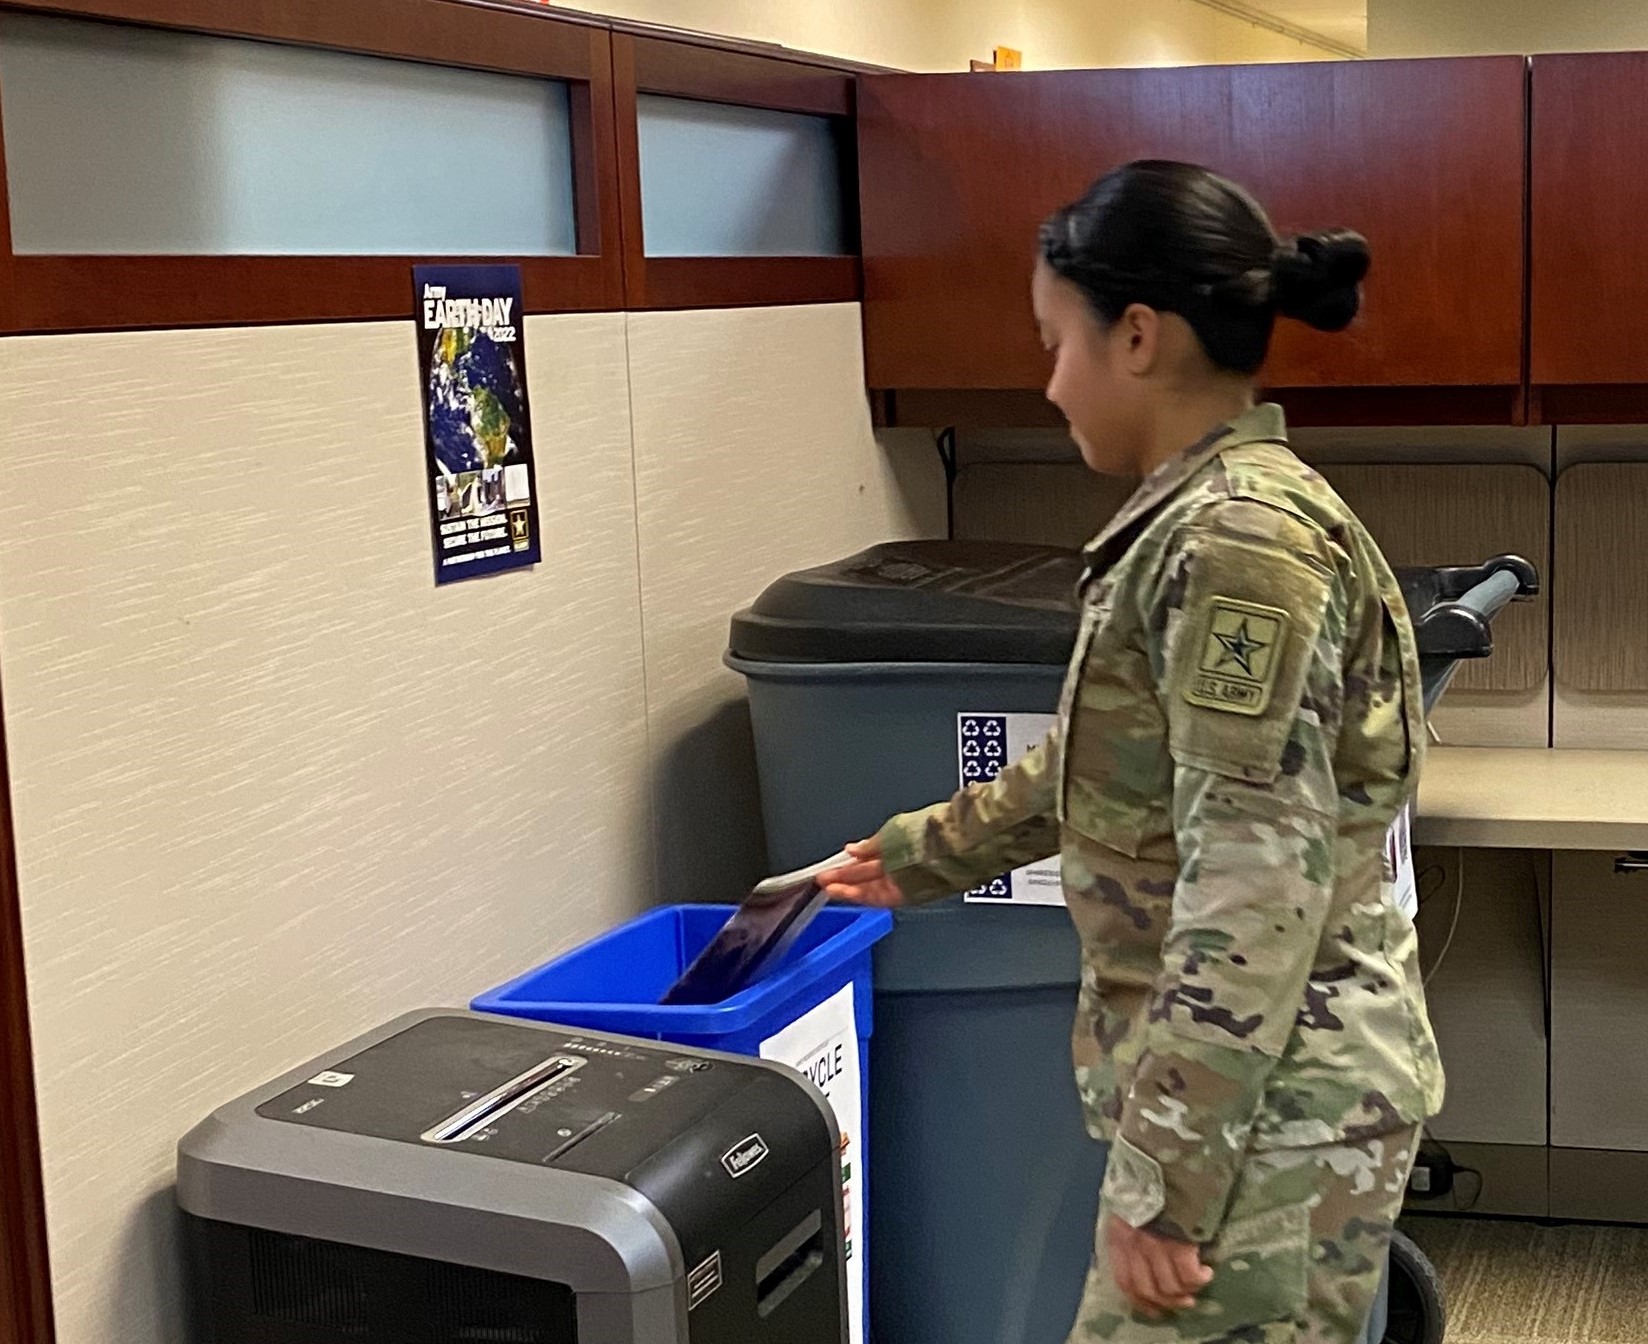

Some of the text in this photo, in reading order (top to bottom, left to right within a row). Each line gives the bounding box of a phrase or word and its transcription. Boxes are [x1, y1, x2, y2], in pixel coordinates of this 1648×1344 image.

[423, 297, 514, 330] EARTH DAY
[1221, 684, 1256, 702] ARMY
[803, 1043, 843, 1088] YCLE
